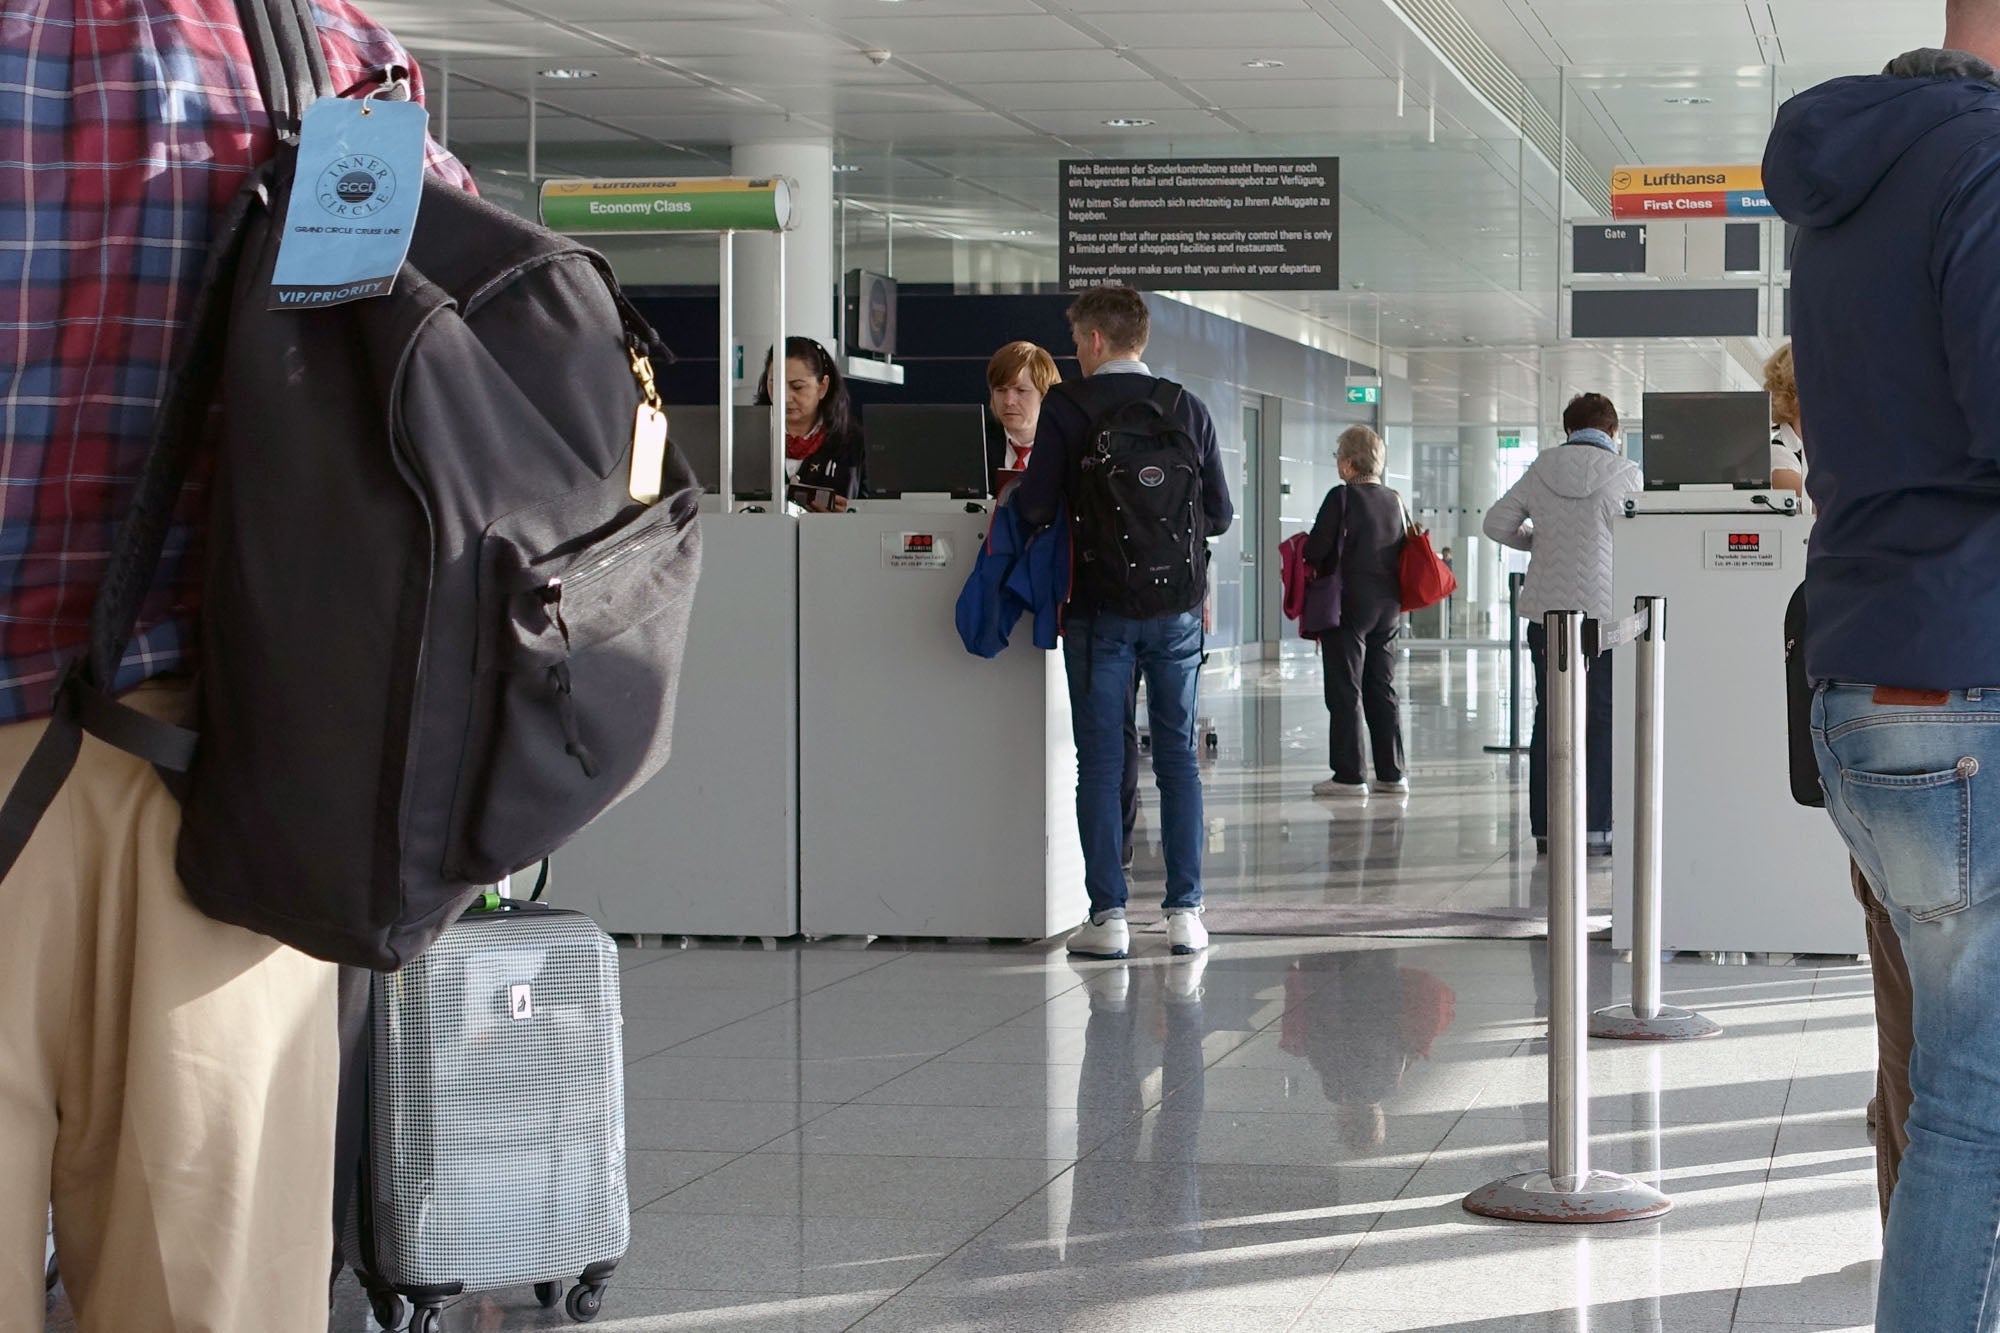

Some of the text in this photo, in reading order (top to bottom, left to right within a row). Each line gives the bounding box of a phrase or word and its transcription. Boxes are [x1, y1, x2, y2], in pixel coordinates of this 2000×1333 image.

[329, 157, 388, 180] INNER
[1068, 163, 1317, 175] Nach Betreten der Sonderkontrollzone steht Ihnen nur noch
[1068, 175, 1326, 189] ein begrenztes Retail und Gastronomieangebot zur Verfügung.
[1643, 173, 1726, 187] Lufthansa
[337, 182, 375, 193] GCCL
[320, 193, 389, 216] CIRCLE
[590, 199, 692, 215] Economy Class
[1068, 198, 1085, 208] Wir
[1087, 198, 1111, 208] bitten
[1113, 198, 1127, 208] Sie
[1129, 198, 1165, 208] dennoch
[1167, 197, 1185, 207] sich
[1187, 197, 1231, 209] rechtzeitig
[1245, 197, 1269, 206] Ihrem
[1271, 196, 1318, 208] Abfluggate
[1643, 200, 1674, 211] First
[1675, 199, 1712, 209] Class
[1068, 211, 1108, 222] begeben.
[295, 226, 322, 234] GRAND
[325, 227, 353, 235] CIRCLE
[1068, 230, 1333, 242] Please note that after passing the security control there is only
[1604, 228, 1626, 239] Gate
[1076, 243, 1106, 254] limited
[1107, 243, 1127, 253] offer
[1129, 243, 1138, 253] of
[1140, 242, 1178, 255] shopping
[1180, 243, 1216, 253] facilities
[1217, 243, 1234, 252] and
[1236, 244, 1286, 252] restaurants.
[1068, 263, 1322, 276] However please make sure that you arrive at your departure
[1068, 279, 1088, 289] gate
[278, 282, 383, 304] VIP/PRIORITY
